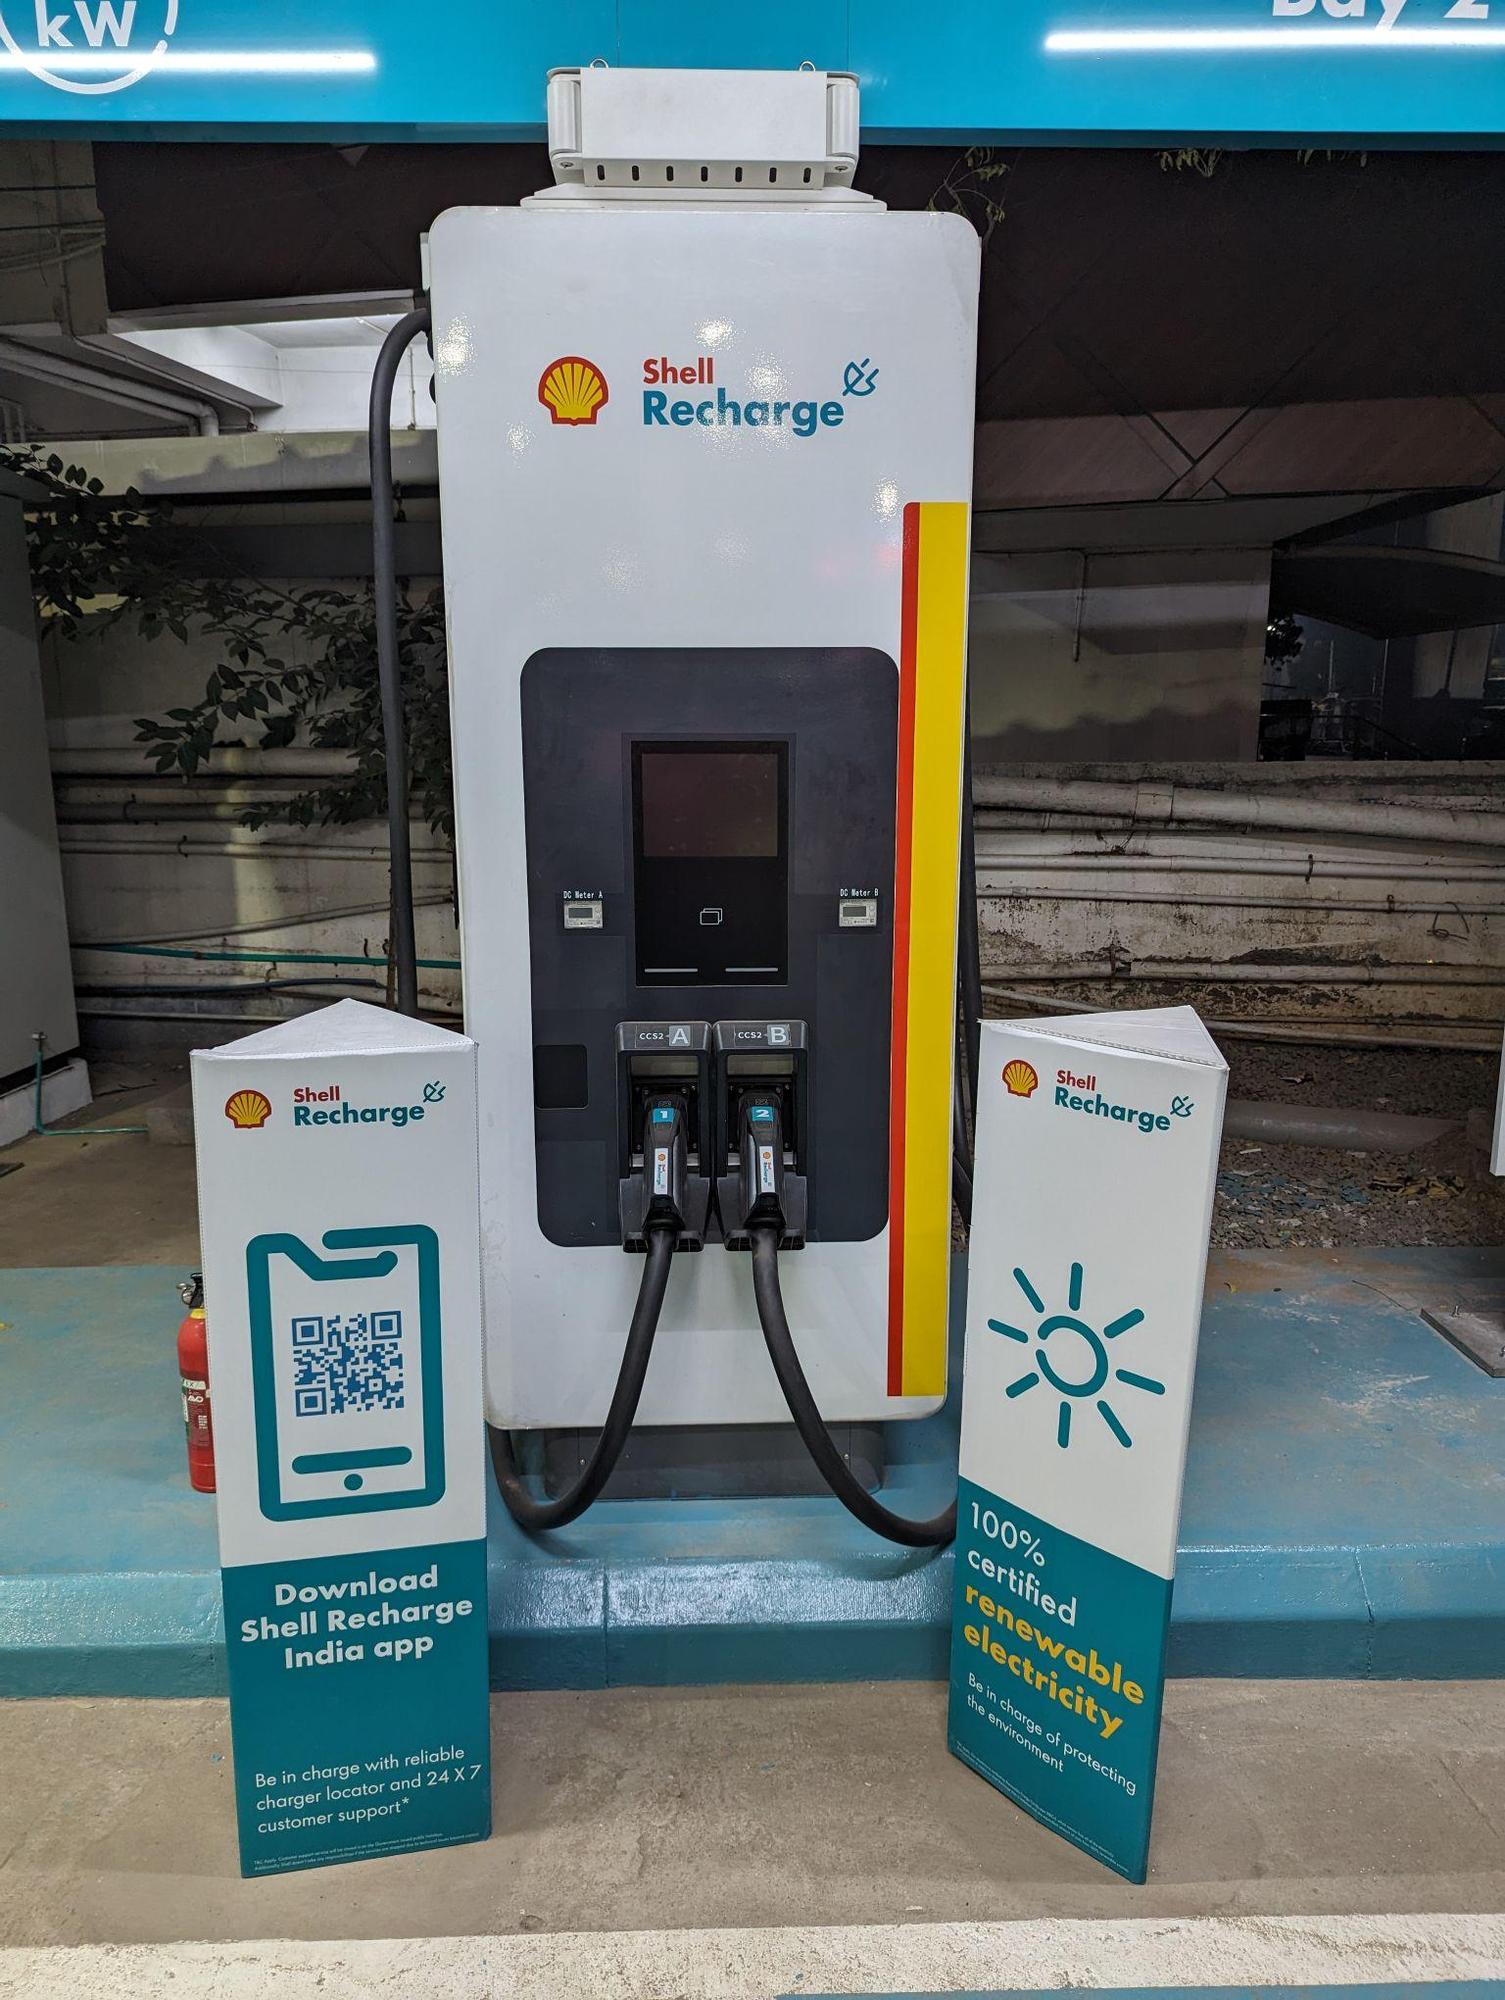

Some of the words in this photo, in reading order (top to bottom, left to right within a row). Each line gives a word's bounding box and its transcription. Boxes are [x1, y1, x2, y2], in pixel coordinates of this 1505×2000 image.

[35, 0, 138, 47] kW
[642, 357, 714, 384] Shell
[642, 387, 845, 437] Recharge
[563, 890, 572, 899] DC
[574, 890, 595, 899] Meter
[598, 890, 604, 899] A
[840, 888, 849, 897] DC
[851, 888, 871, 897] Meter
[874, 887, 879, 897] B
[671, 1028, 689, 1044] A
[770, 1026, 787, 1043] B
[293, 1085, 340, 1103] Shell
[1056, 1070, 1096, 1091] Shell
[293, 1101, 425, 1127] Recharge
[660, 1110, 669, 1119] 1
[755, 1109, 770, 1118] 2
[1054, 1085, 1171, 1133] Recharge
[971, 1502, 1046, 1567] 100%
[275, 1564, 438, 1606] Download
[967, 1549, 1077, 1627] certified
[241, 1610, 317, 1642] Shell
[327, 1599, 474, 1632] Recharge
[285, 1639, 365, 1669] India
[373, 1635, 434, 1662] app
[965, 1584, 1146, 1705] renewable
[963, 1624, 1124, 1739] electricity
[967, 1694, 985, 1717] the
[988, 1713, 1065, 1773] environment
[968, 1671, 983, 1693] Be
[986, 1685, 997, 1704] in
[1000, 1694, 1042, 1736] charge
[1046, 1730, 1061, 1748] of
[1063, 1742, 1136, 1796] protecting
[255, 1773, 277, 1788] Be
[282, 1770, 296, 1784] in
[302, 1764, 360, 1782] charge
[365, 1753, 399, 1772] with
[405, 1744, 465, 1767] reliable
[256, 1791, 322, 1811] charger
[326, 1781, 386, 1801] locator
[390, 1772, 422, 1791] and
[426, 1769, 450, 1787] 24
[454, 1767, 465, 1783] X
[470, 1764, 482, 1781] 7
[258, 1813, 333, 1834] customer
